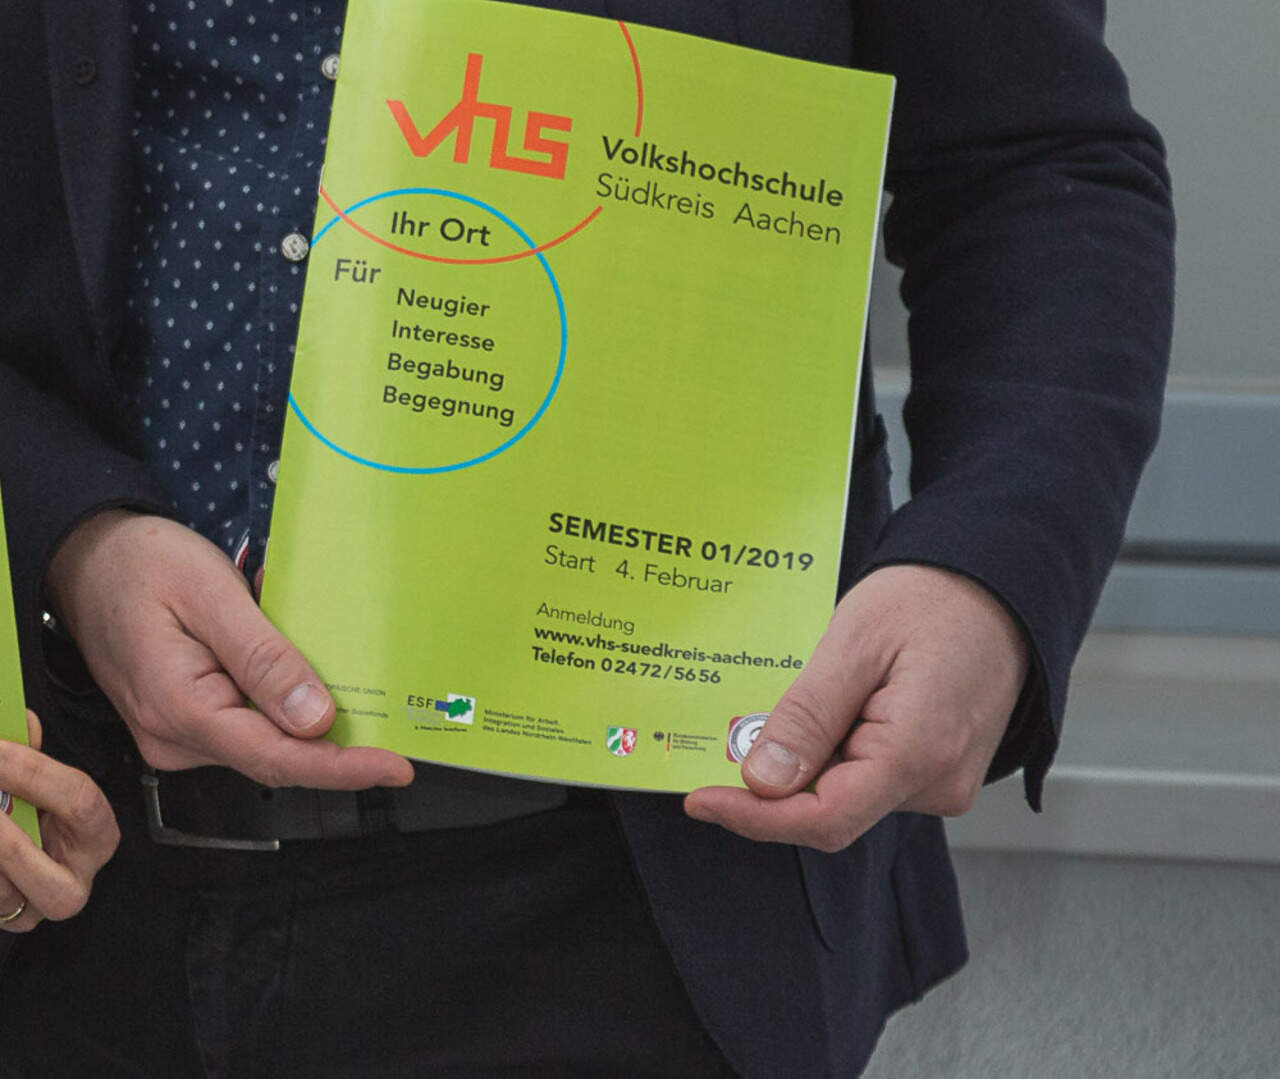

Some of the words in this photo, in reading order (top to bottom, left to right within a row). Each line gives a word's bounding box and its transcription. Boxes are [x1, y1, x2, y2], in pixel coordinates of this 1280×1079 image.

[600, 135, 844, 209] Volkshochschule
[596, 172, 716, 221] Südkreis
[733, 204, 842, 246] Aachen
[390, 210, 434, 240] Ihr
[439, 215, 491, 248] Ort
[333, 257, 382, 286] Für
[396, 287, 491, 321] Neugier
[391, 320, 495, 353] Interesse
[386, 352, 505, 392] Begabung
[382, 384, 515, 427] Begegnung
[547, 511, 693, 561] SEMESTER
[700, 538, 815, 574] 01/2019
[543, 544, 596, 575] Start
[616, 557, 636, 582] 4.
[643, 562, 733, 594] Februar
[536, 602, 635, 636] Anmeldung
[532, 646, 595, 670] Telefon
[534, 627, 803, 670] www.vhs-suedkreis-aachen.de
[407, 695, 434, 709] ESF
